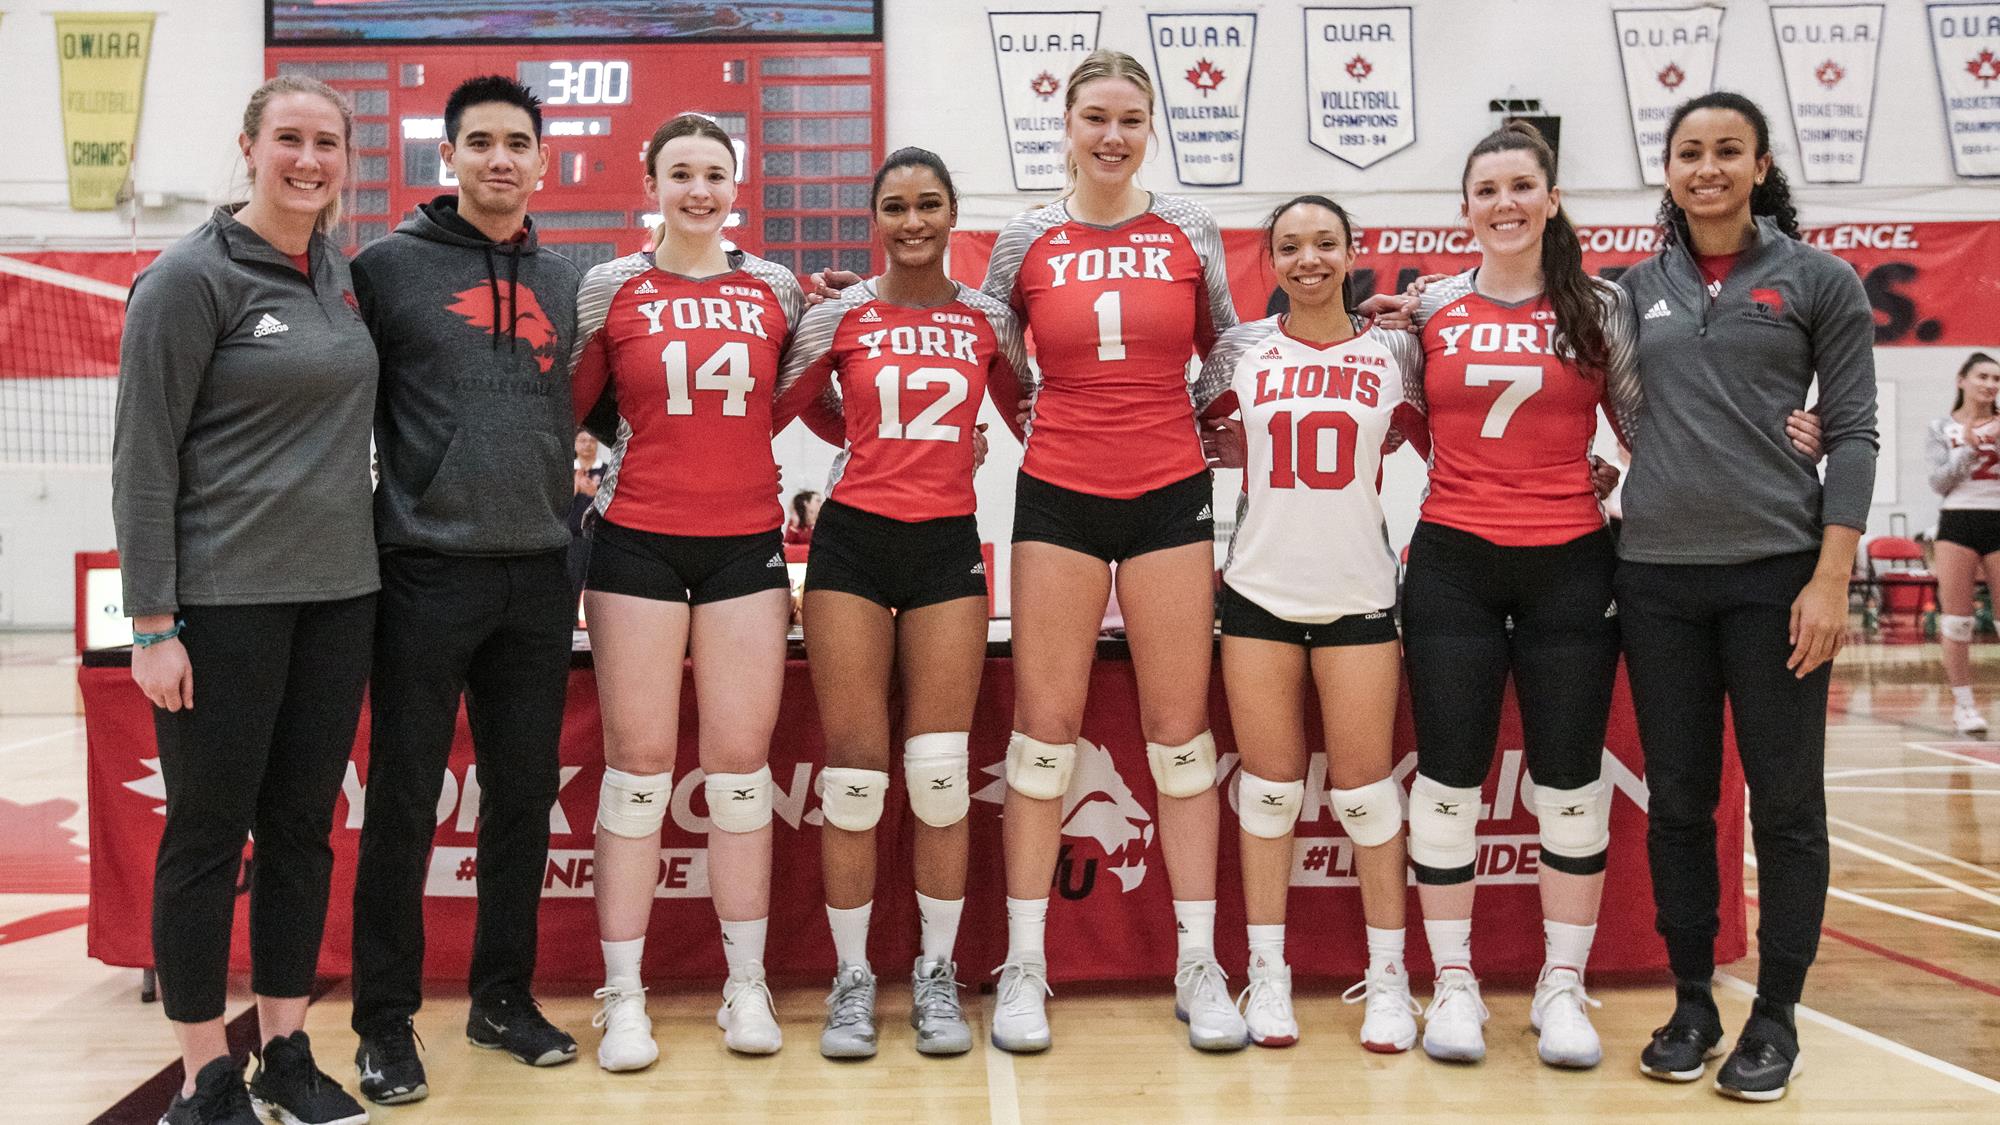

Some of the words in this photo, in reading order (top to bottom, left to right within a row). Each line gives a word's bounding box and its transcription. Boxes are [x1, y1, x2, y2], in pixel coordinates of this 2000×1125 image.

[547, 61, 629, 104] 3:00
[1170, 105, 1240, 119] VOLLEYBALL
[1321, 91, 1400, 110] VOLLEYBALL
[1014, 117, 1065, 131] VOLLEYBA
[1322, 114, 1398, 128] CHAMPIONS
[1176, 129, 1240, 143] CHAMPIONS
[1799, 127, 1864, 143] CHAMPIONS
[73, 140, 127, 167] CHAMPS
[1128, 232, 1175, 244] OUA
[1377, 230, 1482, 253] DEDICA
[1047, 246, 1174, 288] YORK
[719, 285, 764, 300] OUA
[637, 298, 769, 340] YORK
[931, 312, 976, 327] OUA
[1094, 291, 1126, 361] 1
[253, 324, 289, 338] adidas
[858, 326, 979, 366] YORK
[1343, 354, 1388, 368] OUA
[661, 341, 756, 417] 14
[1253, 364, 1381, 408] LIONS
[875, 365, 969, 442] 12
[1464, 364, 1544, 439] 7
[1268, 411, 1359, 490] 10
